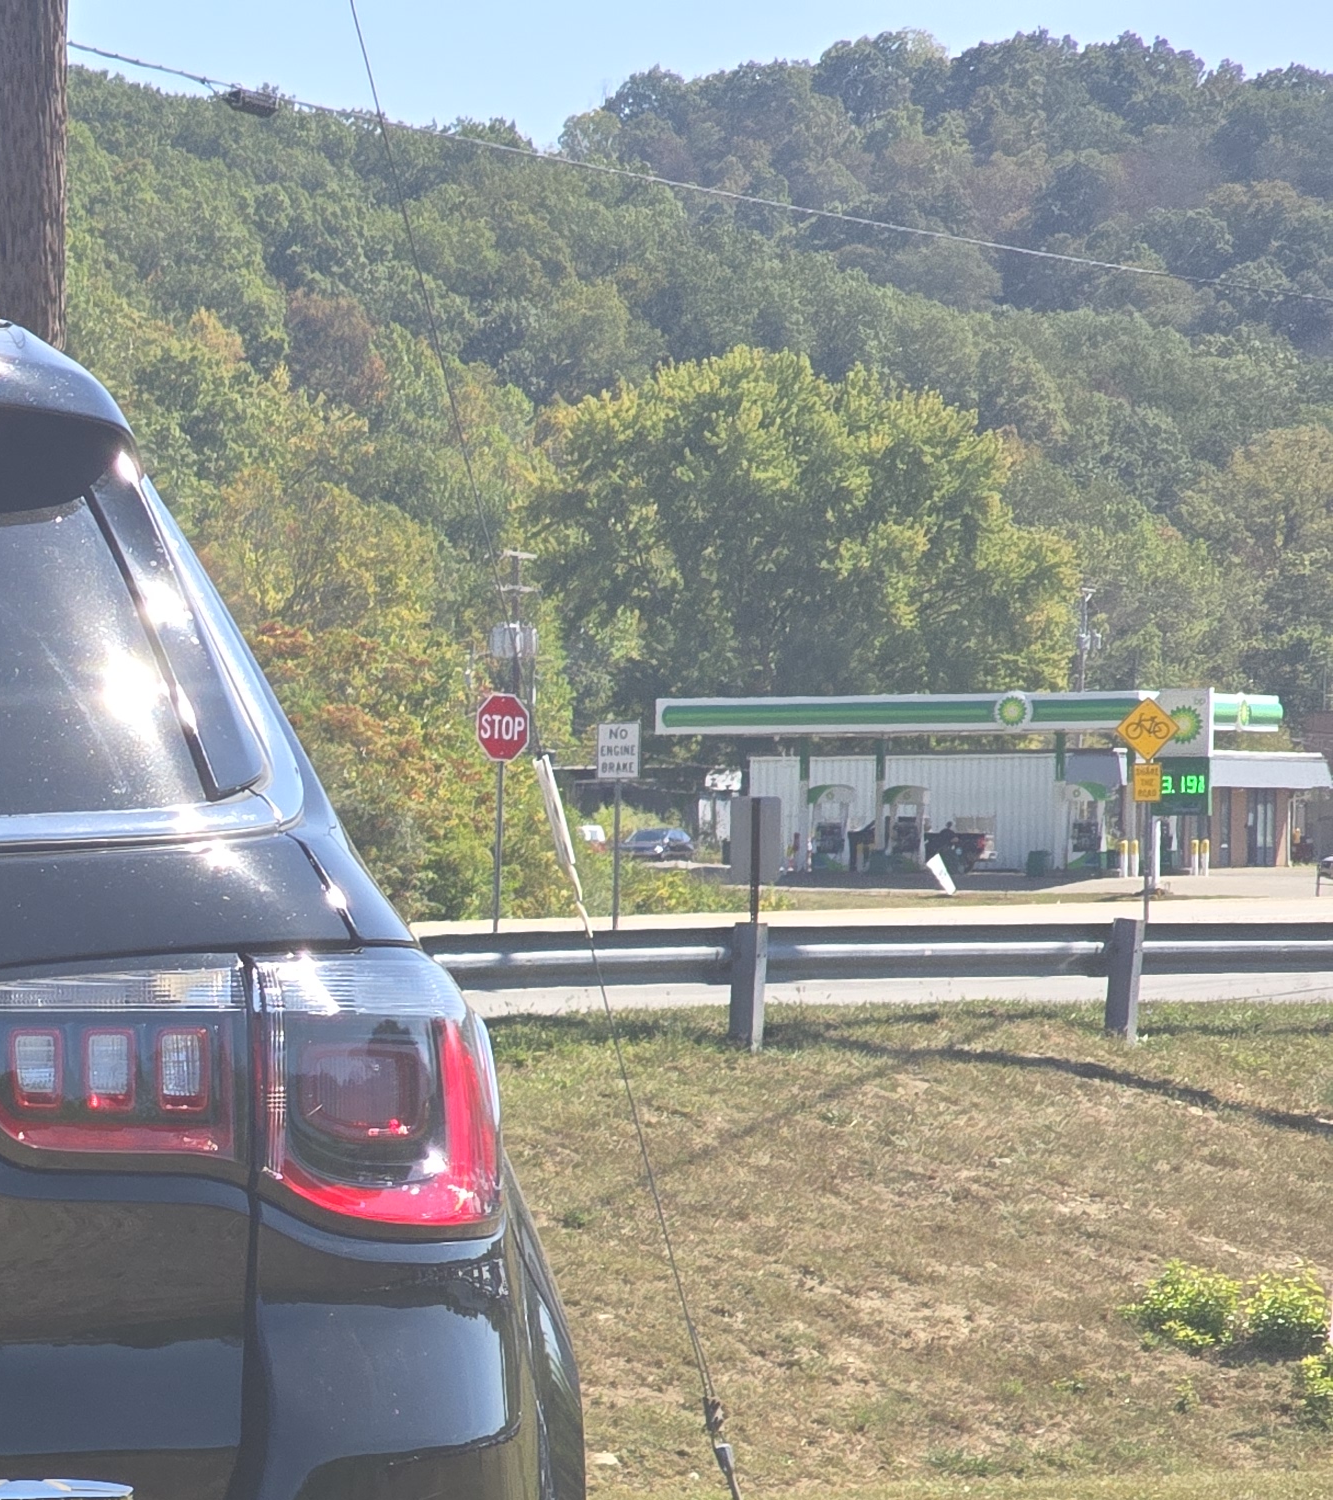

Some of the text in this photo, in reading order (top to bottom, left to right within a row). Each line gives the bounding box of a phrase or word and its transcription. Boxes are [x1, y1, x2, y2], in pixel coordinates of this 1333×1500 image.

[481, 714, 525, 740] STOP
[609, 728, 628, 740] NO
[600, 745, 636, 757] ENGINE
[601, 762, 635, 774] BRAKE
